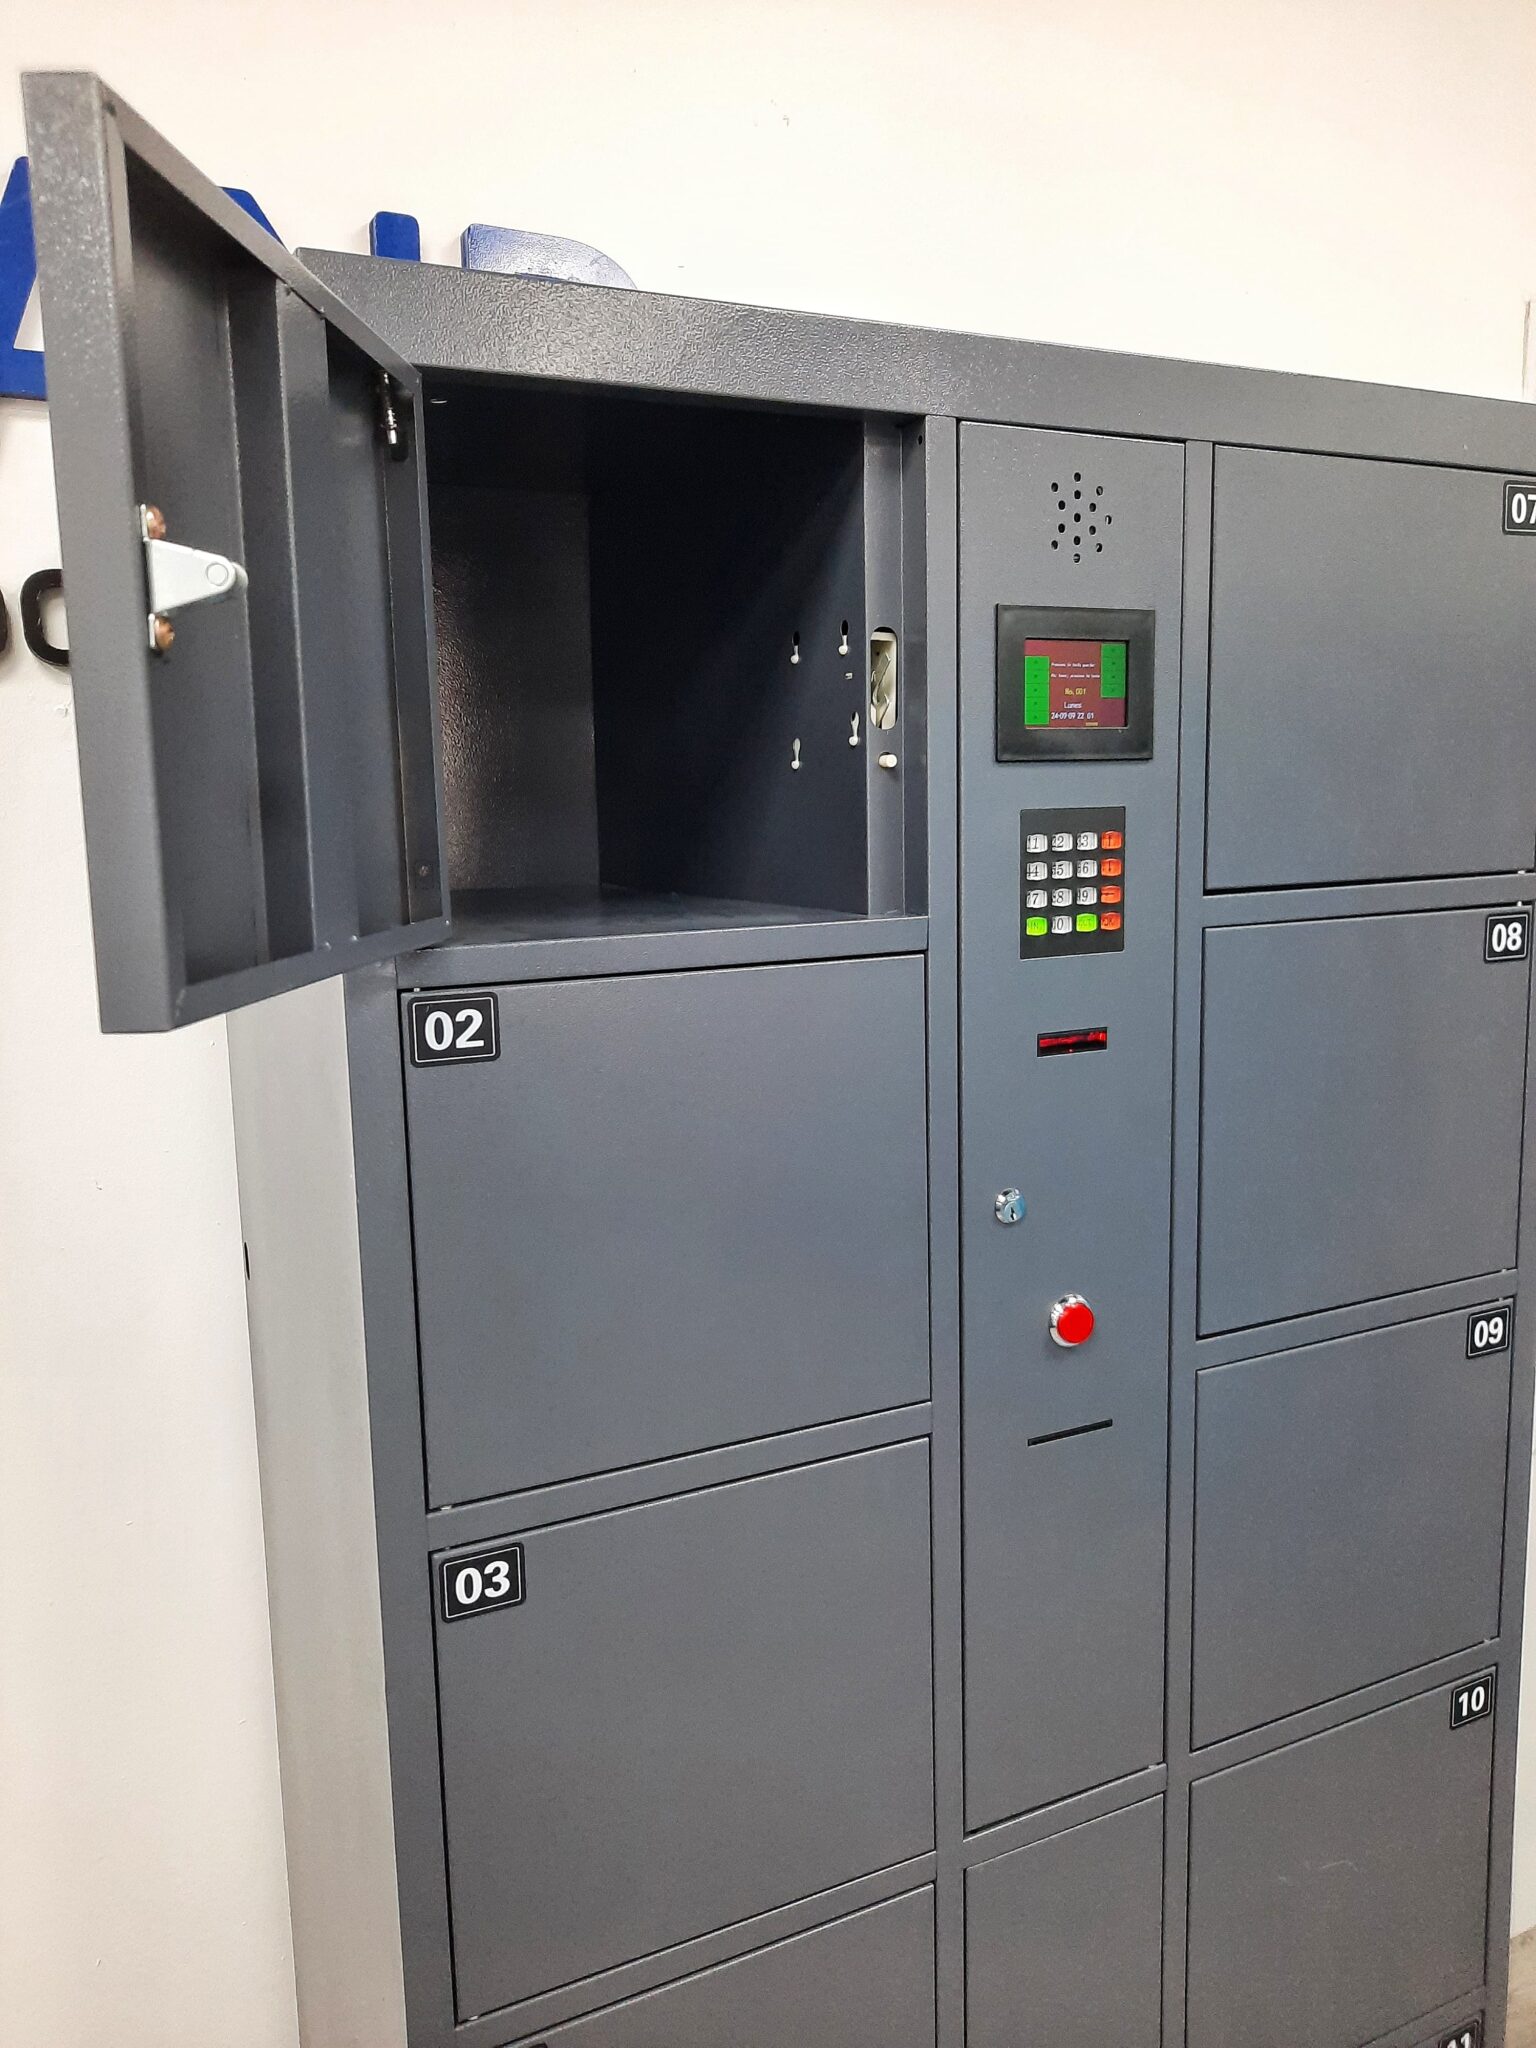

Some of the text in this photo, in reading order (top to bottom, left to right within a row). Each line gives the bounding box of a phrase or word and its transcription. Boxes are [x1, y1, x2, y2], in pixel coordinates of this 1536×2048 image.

[1491, 921, 1523, 953] 08
[424, 1008, 485, 1051] 02
[1474, 1316, 1504, 1348] 09
[455, 1560, 511, 1605] 03
[1458, 1686, 1485, 1717] 10
